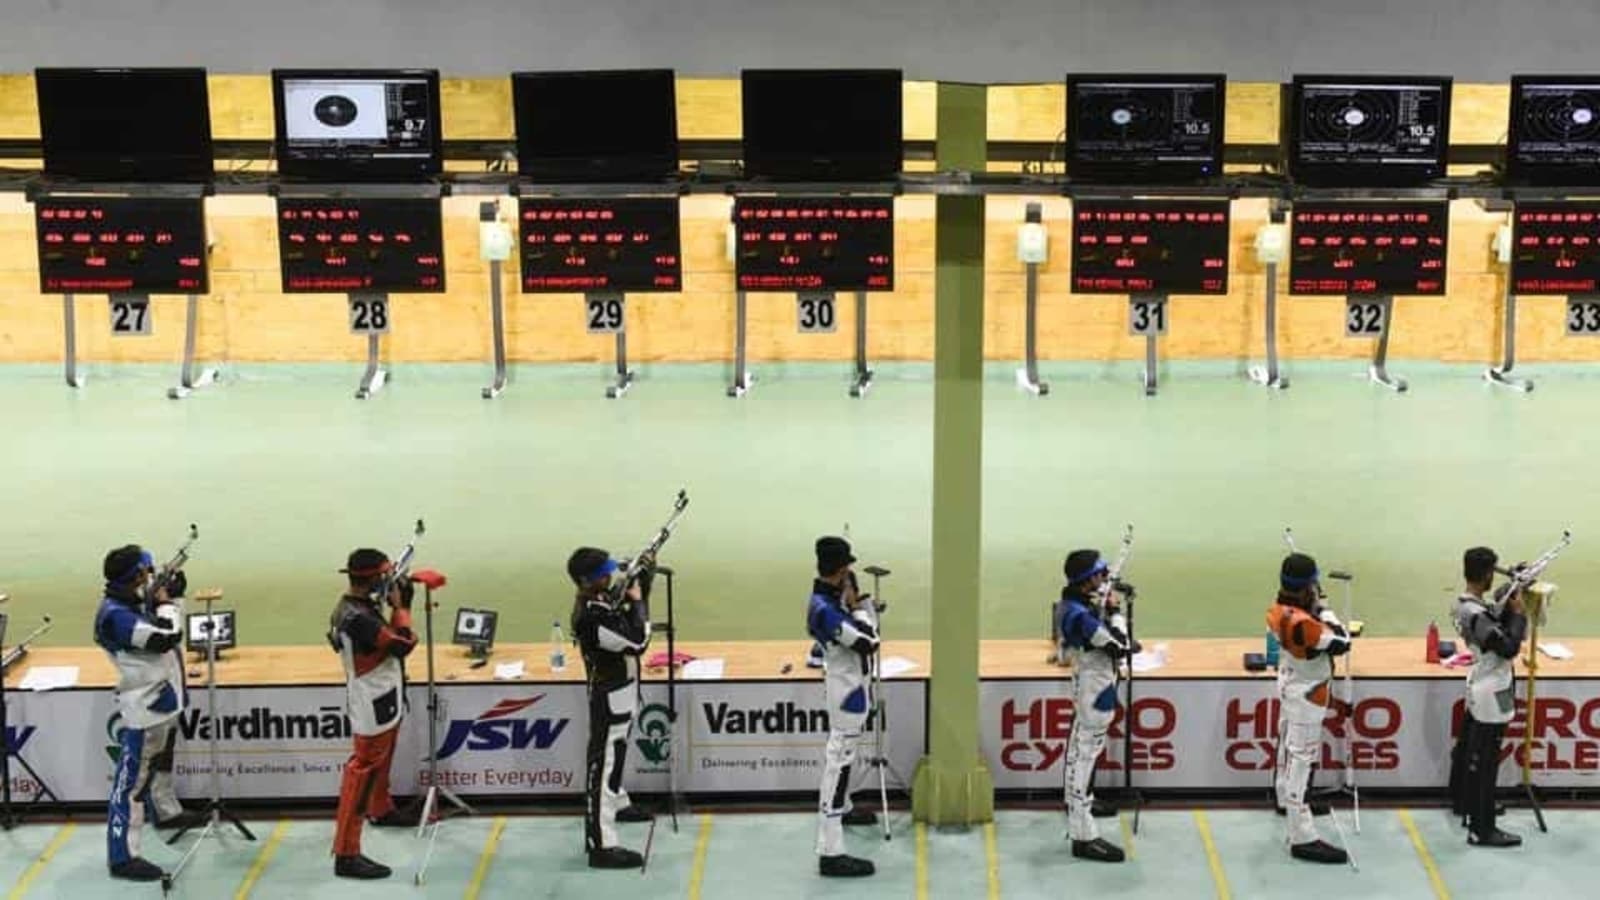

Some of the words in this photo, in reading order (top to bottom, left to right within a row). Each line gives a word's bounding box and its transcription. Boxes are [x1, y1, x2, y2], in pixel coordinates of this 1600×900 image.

[1184, 122, 1211, 134] 10.5
[1409, 126, 1436, 137] 10.5
[112, 303, 147, 332] 27
[352, 301, 387, 330] 28
[589, 301, 622, 329] 29
[800, 299, 833, 328] 30
[1134, 302, 1164, 331] 31
[1348, 304, 1381, 333] 32
[1569, 303, 1600, 332] 33
[1226, 698, 1402, 739] HRO
[421, 719, 570, 762] JSW
[1001, 742, 1176, 771] CYLES
[1225, 742, 1400, 771] CYLES
[484, 767, 574, 787] Everyday
